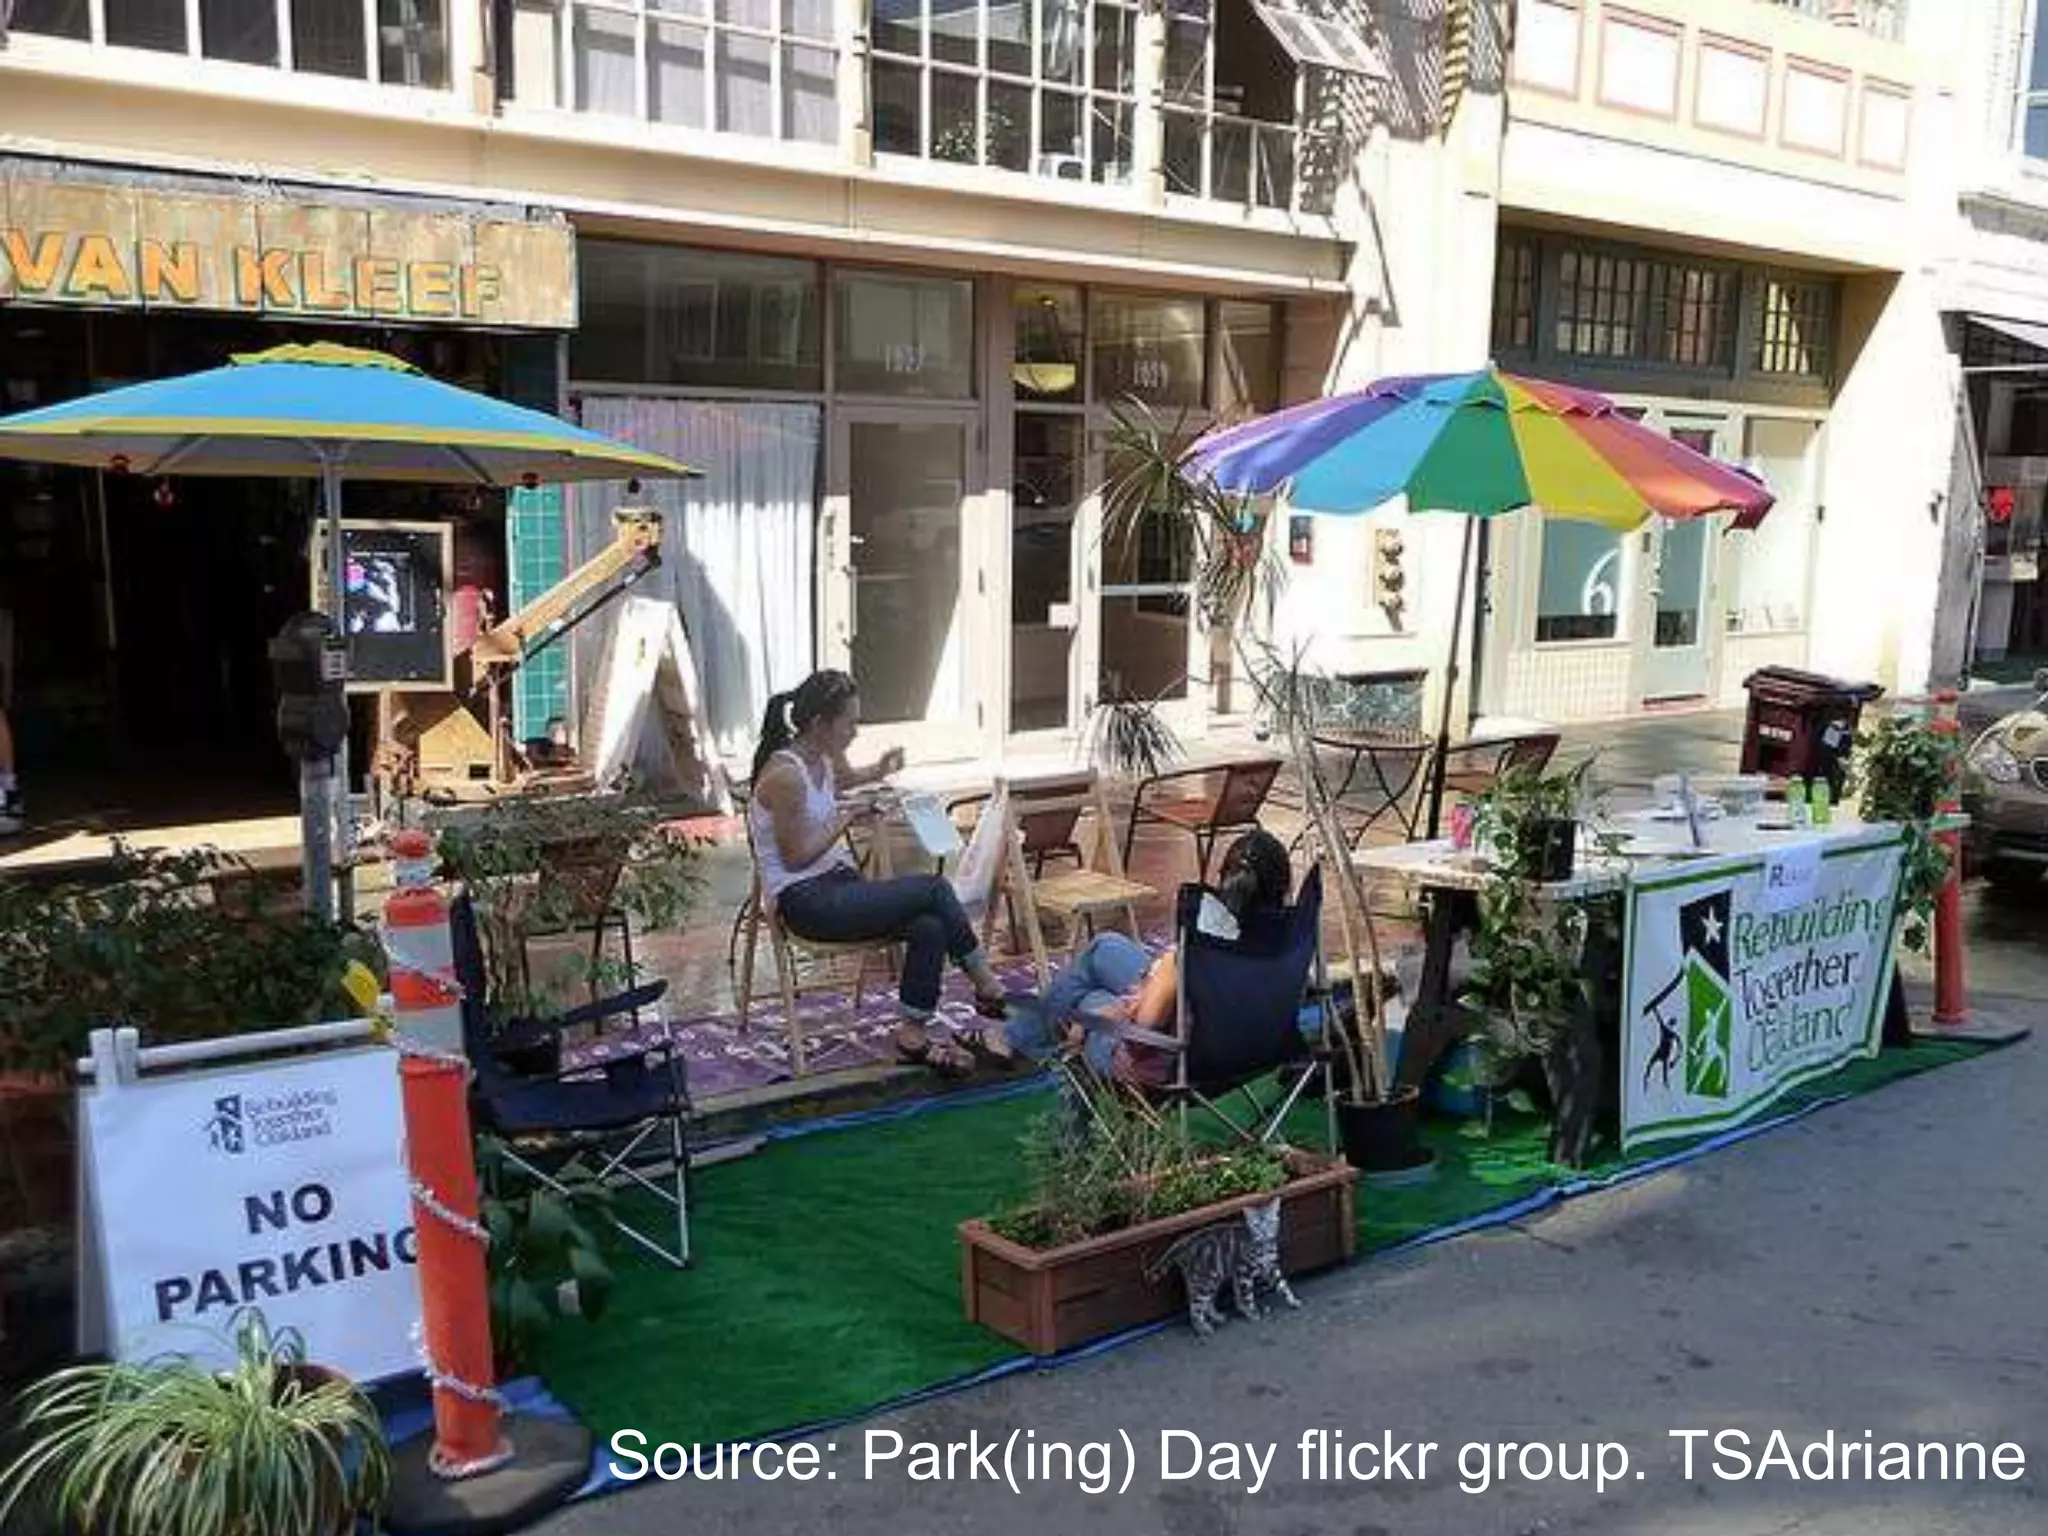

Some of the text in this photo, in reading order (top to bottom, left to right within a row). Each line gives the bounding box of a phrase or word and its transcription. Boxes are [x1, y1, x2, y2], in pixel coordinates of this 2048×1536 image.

[1, 226, 500, 318] VAN KLEEF
[1733, 888, 1890, 966] Rebuilding
[1732, 947, 1860, 1020] Together
[244, 1183, 332, 1234] NO
